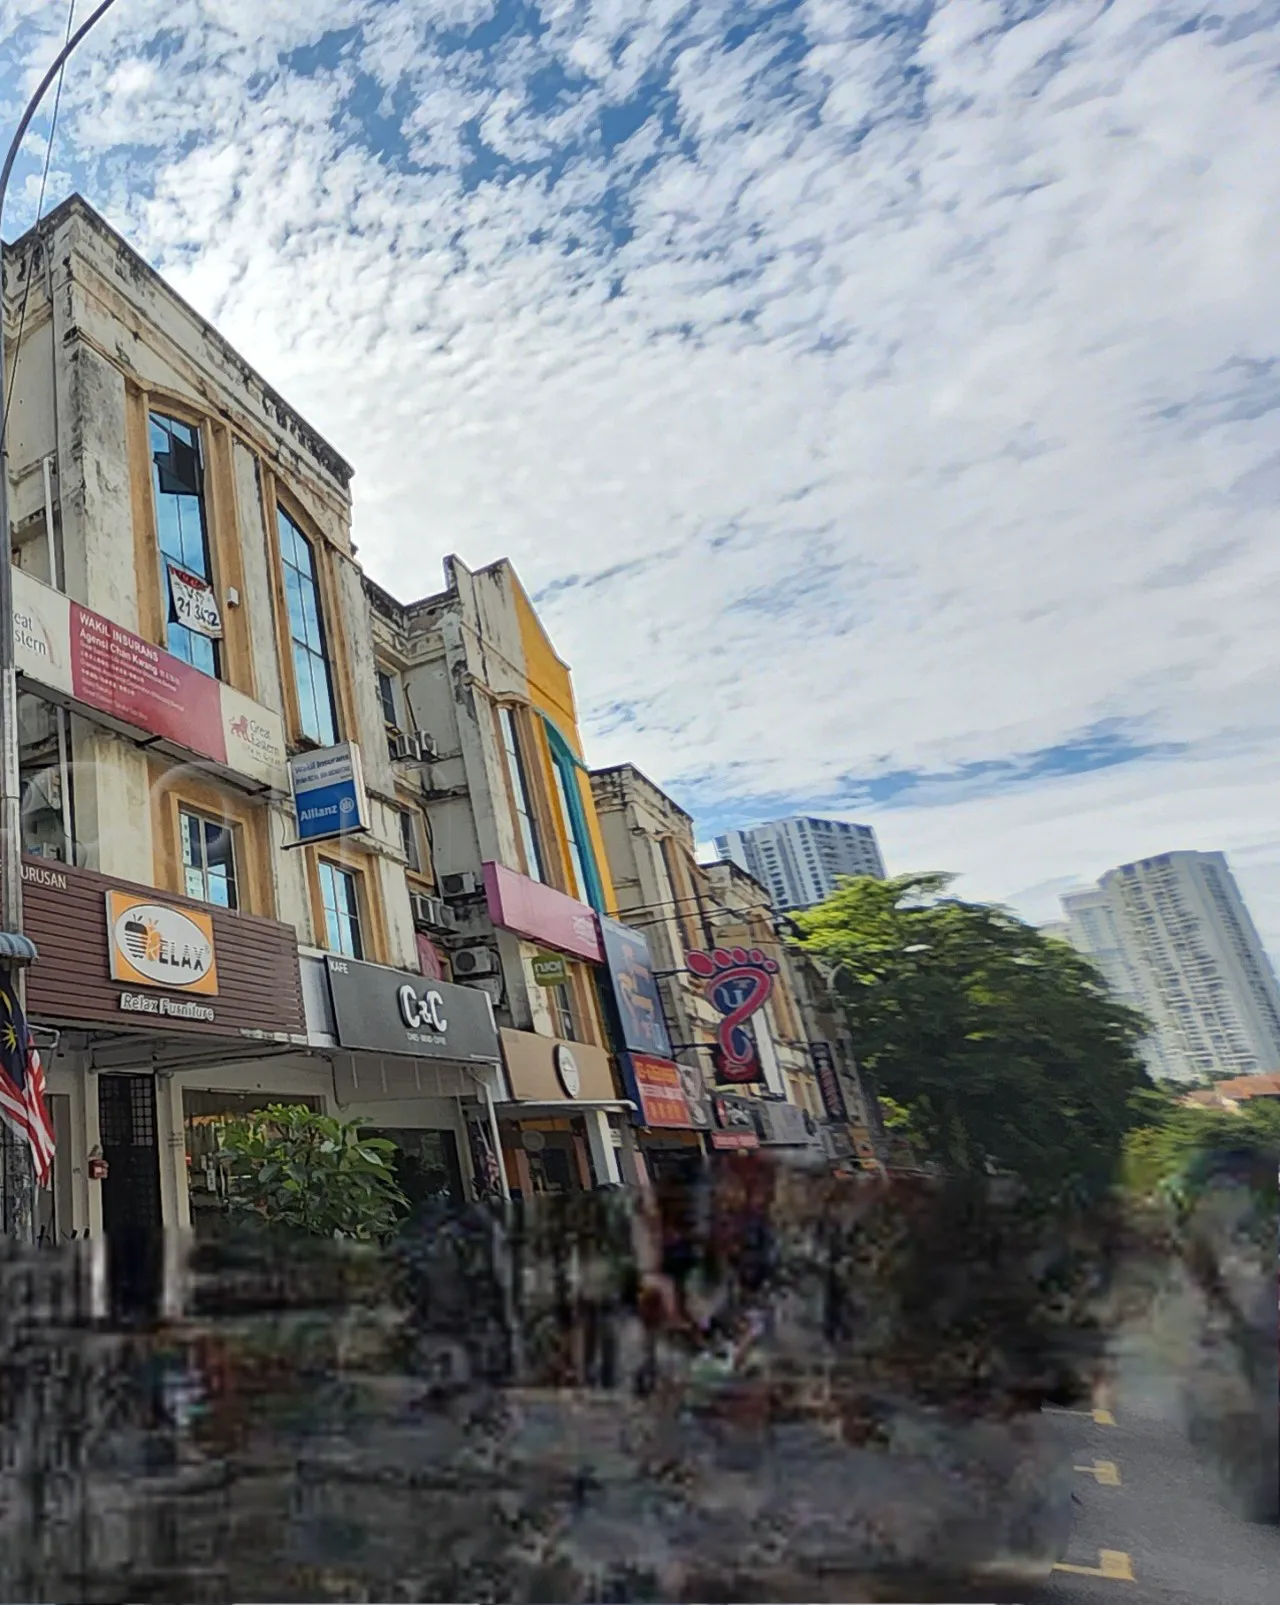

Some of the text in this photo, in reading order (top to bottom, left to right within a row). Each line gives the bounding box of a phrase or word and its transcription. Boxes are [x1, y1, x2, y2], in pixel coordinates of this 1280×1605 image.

[13, 612, 33, 632] eat
[14, 629, 46, 655] stern
[79, 611, 159, 663] WAKIL INSURANS
[79, 627, 109, 650] Agensi
[299, 804, 338, 822] Allianz
[20, 865, 67, 889] URUSAN
[329, 960, 349, 975] KAFE
[120, 992, 215, 1022] Relax Furniture
